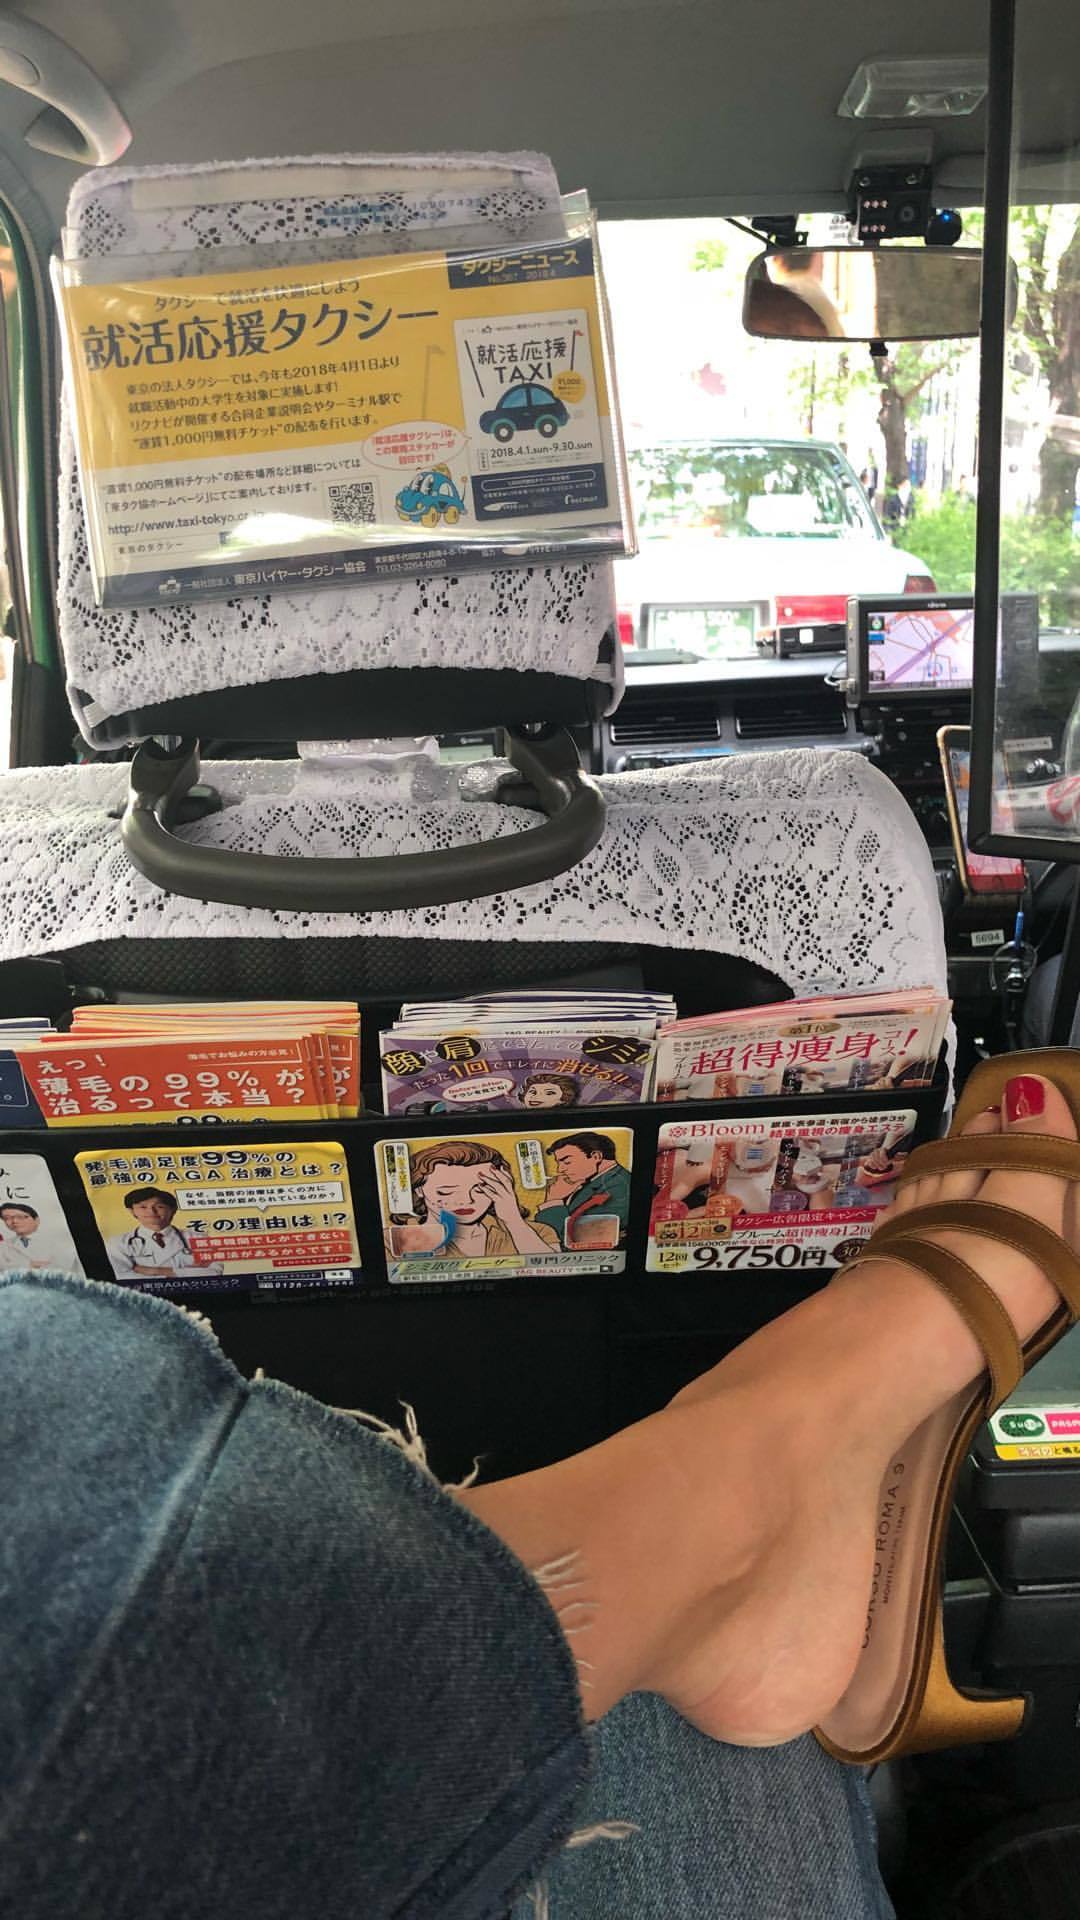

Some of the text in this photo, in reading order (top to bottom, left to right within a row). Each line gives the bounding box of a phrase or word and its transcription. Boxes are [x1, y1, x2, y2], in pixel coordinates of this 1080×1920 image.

[462, 249, 580, 276] タクシーニュース
[81, 300, 439, 371] 就活応援タクシー
[477, 337, 568, 365] 就活応援
[494, 362, 553, 384] TAXI
[37, 1054, 107, 1075] えっ！
[688, 1031, 880, 1077] 超得痩身
[48, 1087, 306, 1116] 治るって本当？
[691, 1122, 765, 1137] Bloom
[693, 1245, 826, 1270] 9,750円
[875, 1485, 900, 1552] ROMA
